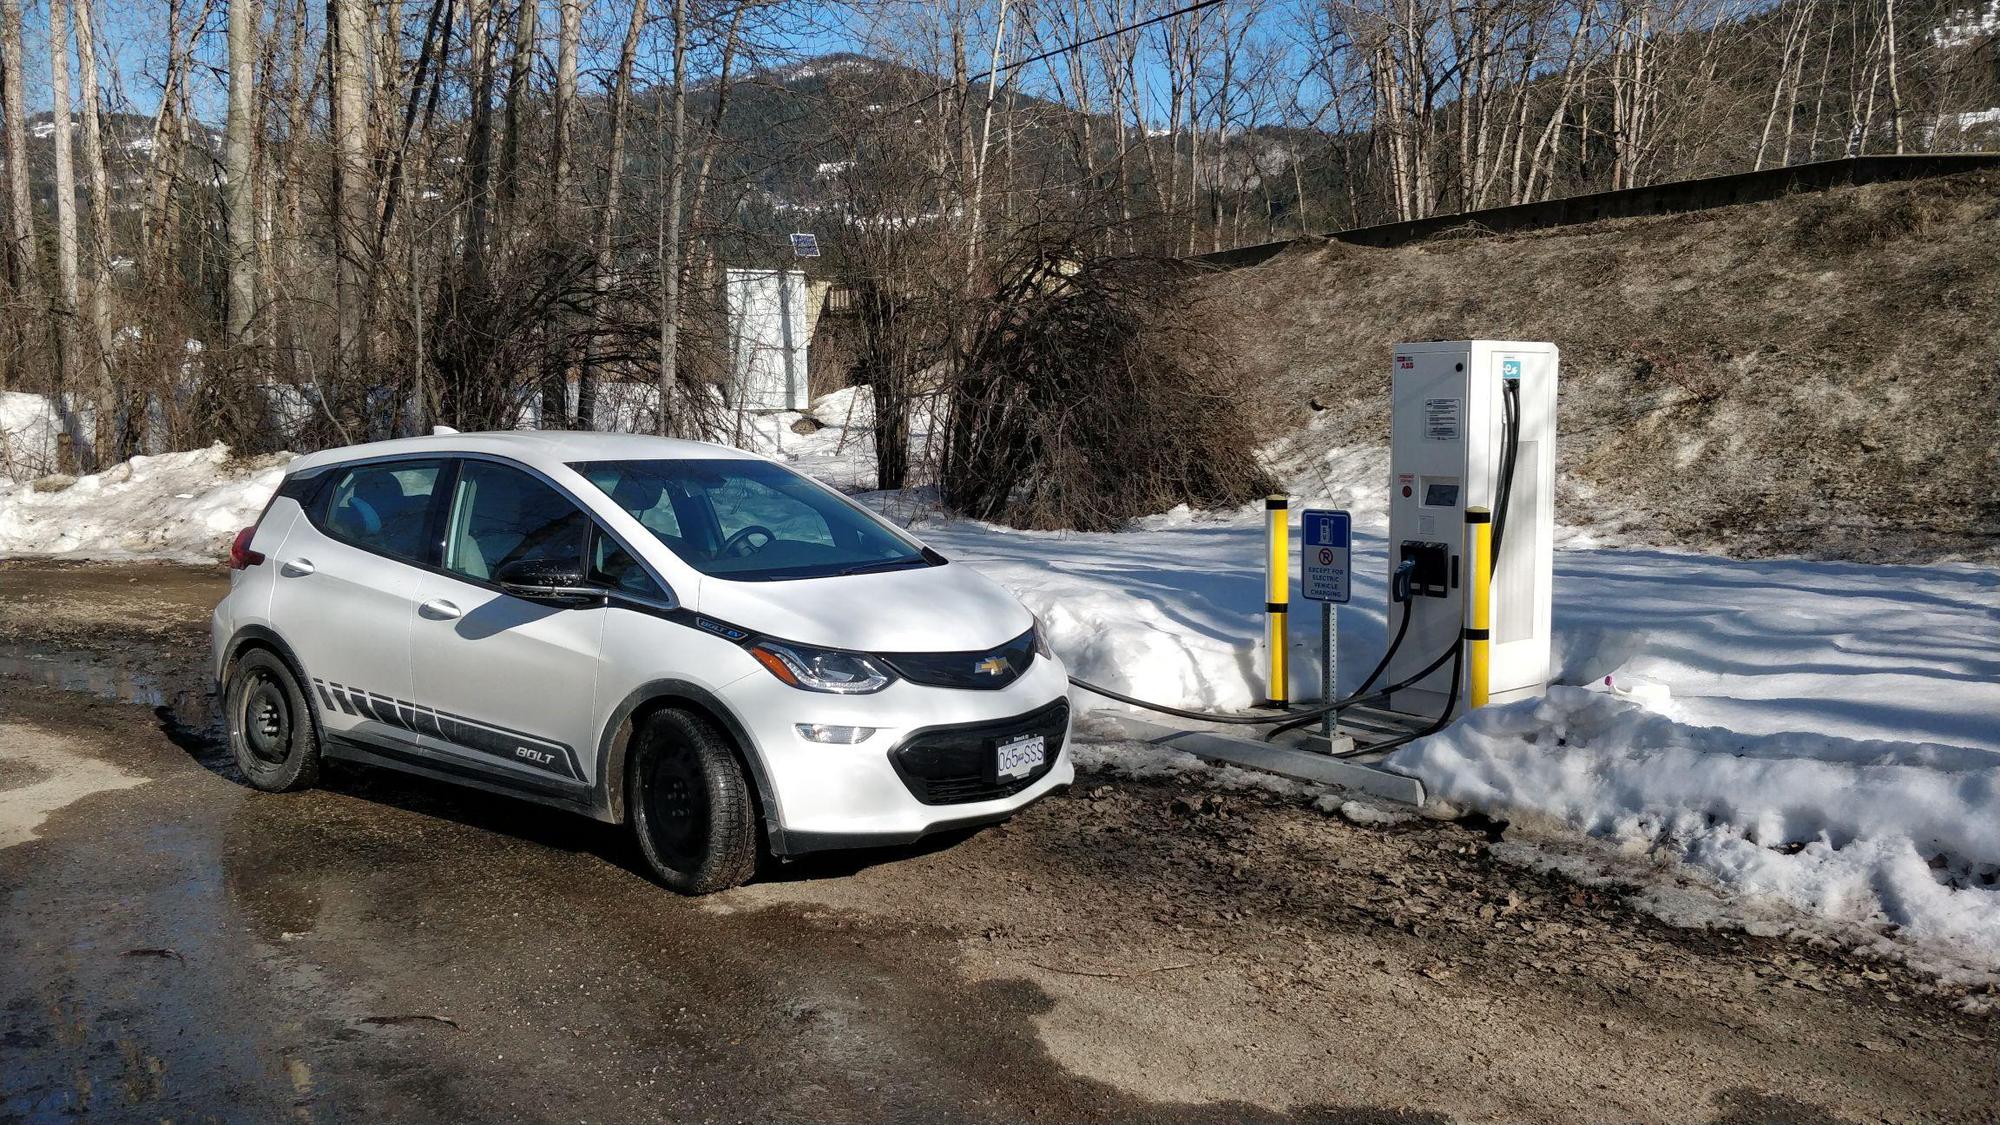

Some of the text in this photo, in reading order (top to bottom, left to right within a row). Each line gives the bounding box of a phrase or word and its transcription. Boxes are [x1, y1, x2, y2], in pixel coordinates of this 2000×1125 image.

[1312, 574, 1340, 582] ELECTRIC
[1314, 582, 1338, 590] VEHICLE
[1310, 589, 1342, 598] CHARGING
[701, 620, 727, 632] BOLT
[516, 746, 555, 764] BOLT
